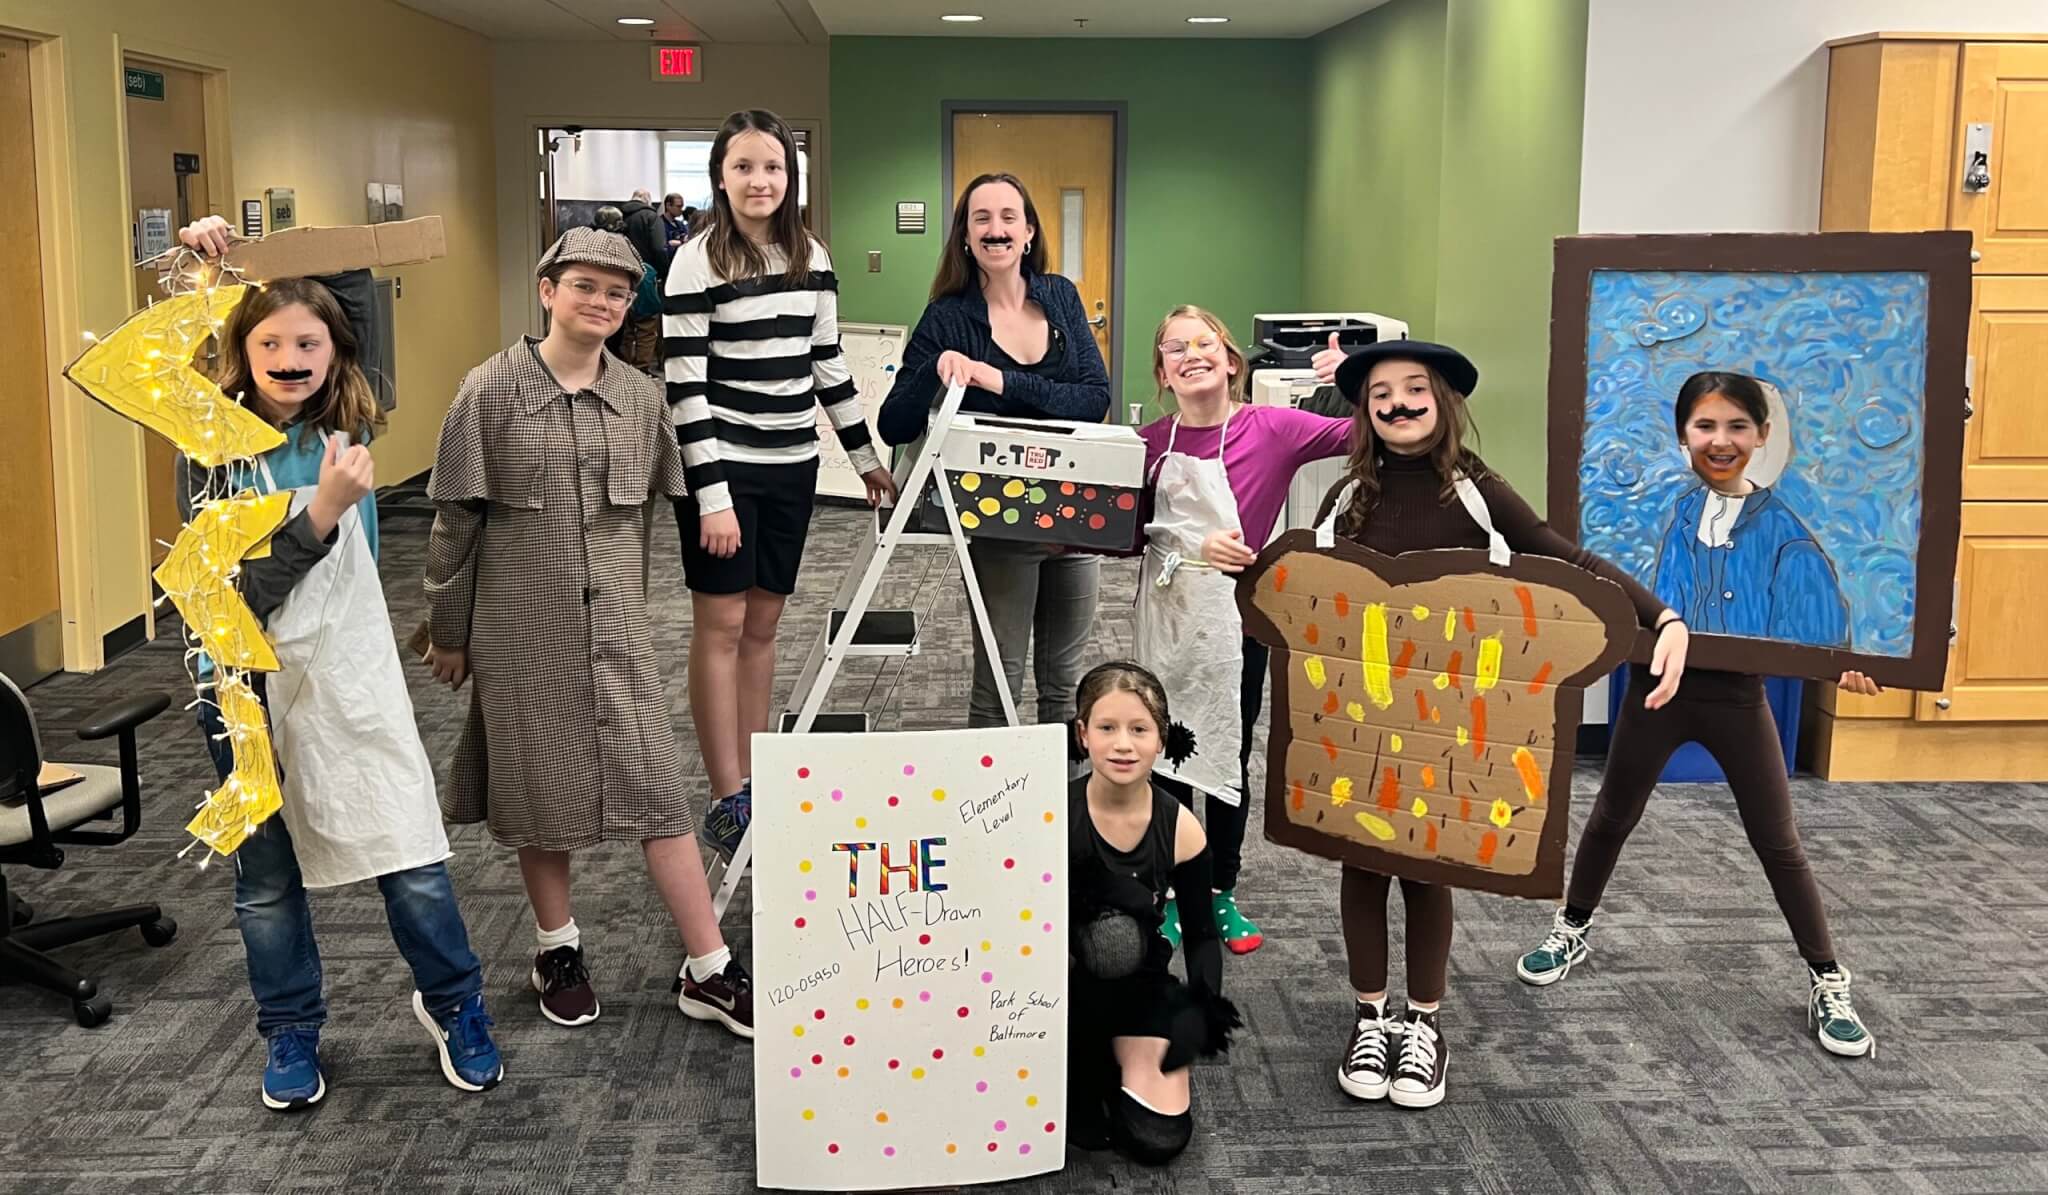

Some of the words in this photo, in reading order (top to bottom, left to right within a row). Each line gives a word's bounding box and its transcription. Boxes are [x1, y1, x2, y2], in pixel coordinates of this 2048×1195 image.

[661, 48, 693, 75] EXIT
[276, 203, 291, 219] seb
[959, 772, 1029, 824] Elementary
[981, 801, 1014, 834] Level
[831, 836, 948, 898] THE
[874, 945, 970, 983] Heroes!
[767, 962, 841, 1007] 120-05950
[990, 989, 1016, 1010] Park
[1027, 990, 1061, 1009] School
[1007, 1006, 1029, 1021] of
[989, 1023, 1047, 1042] Baltimore
